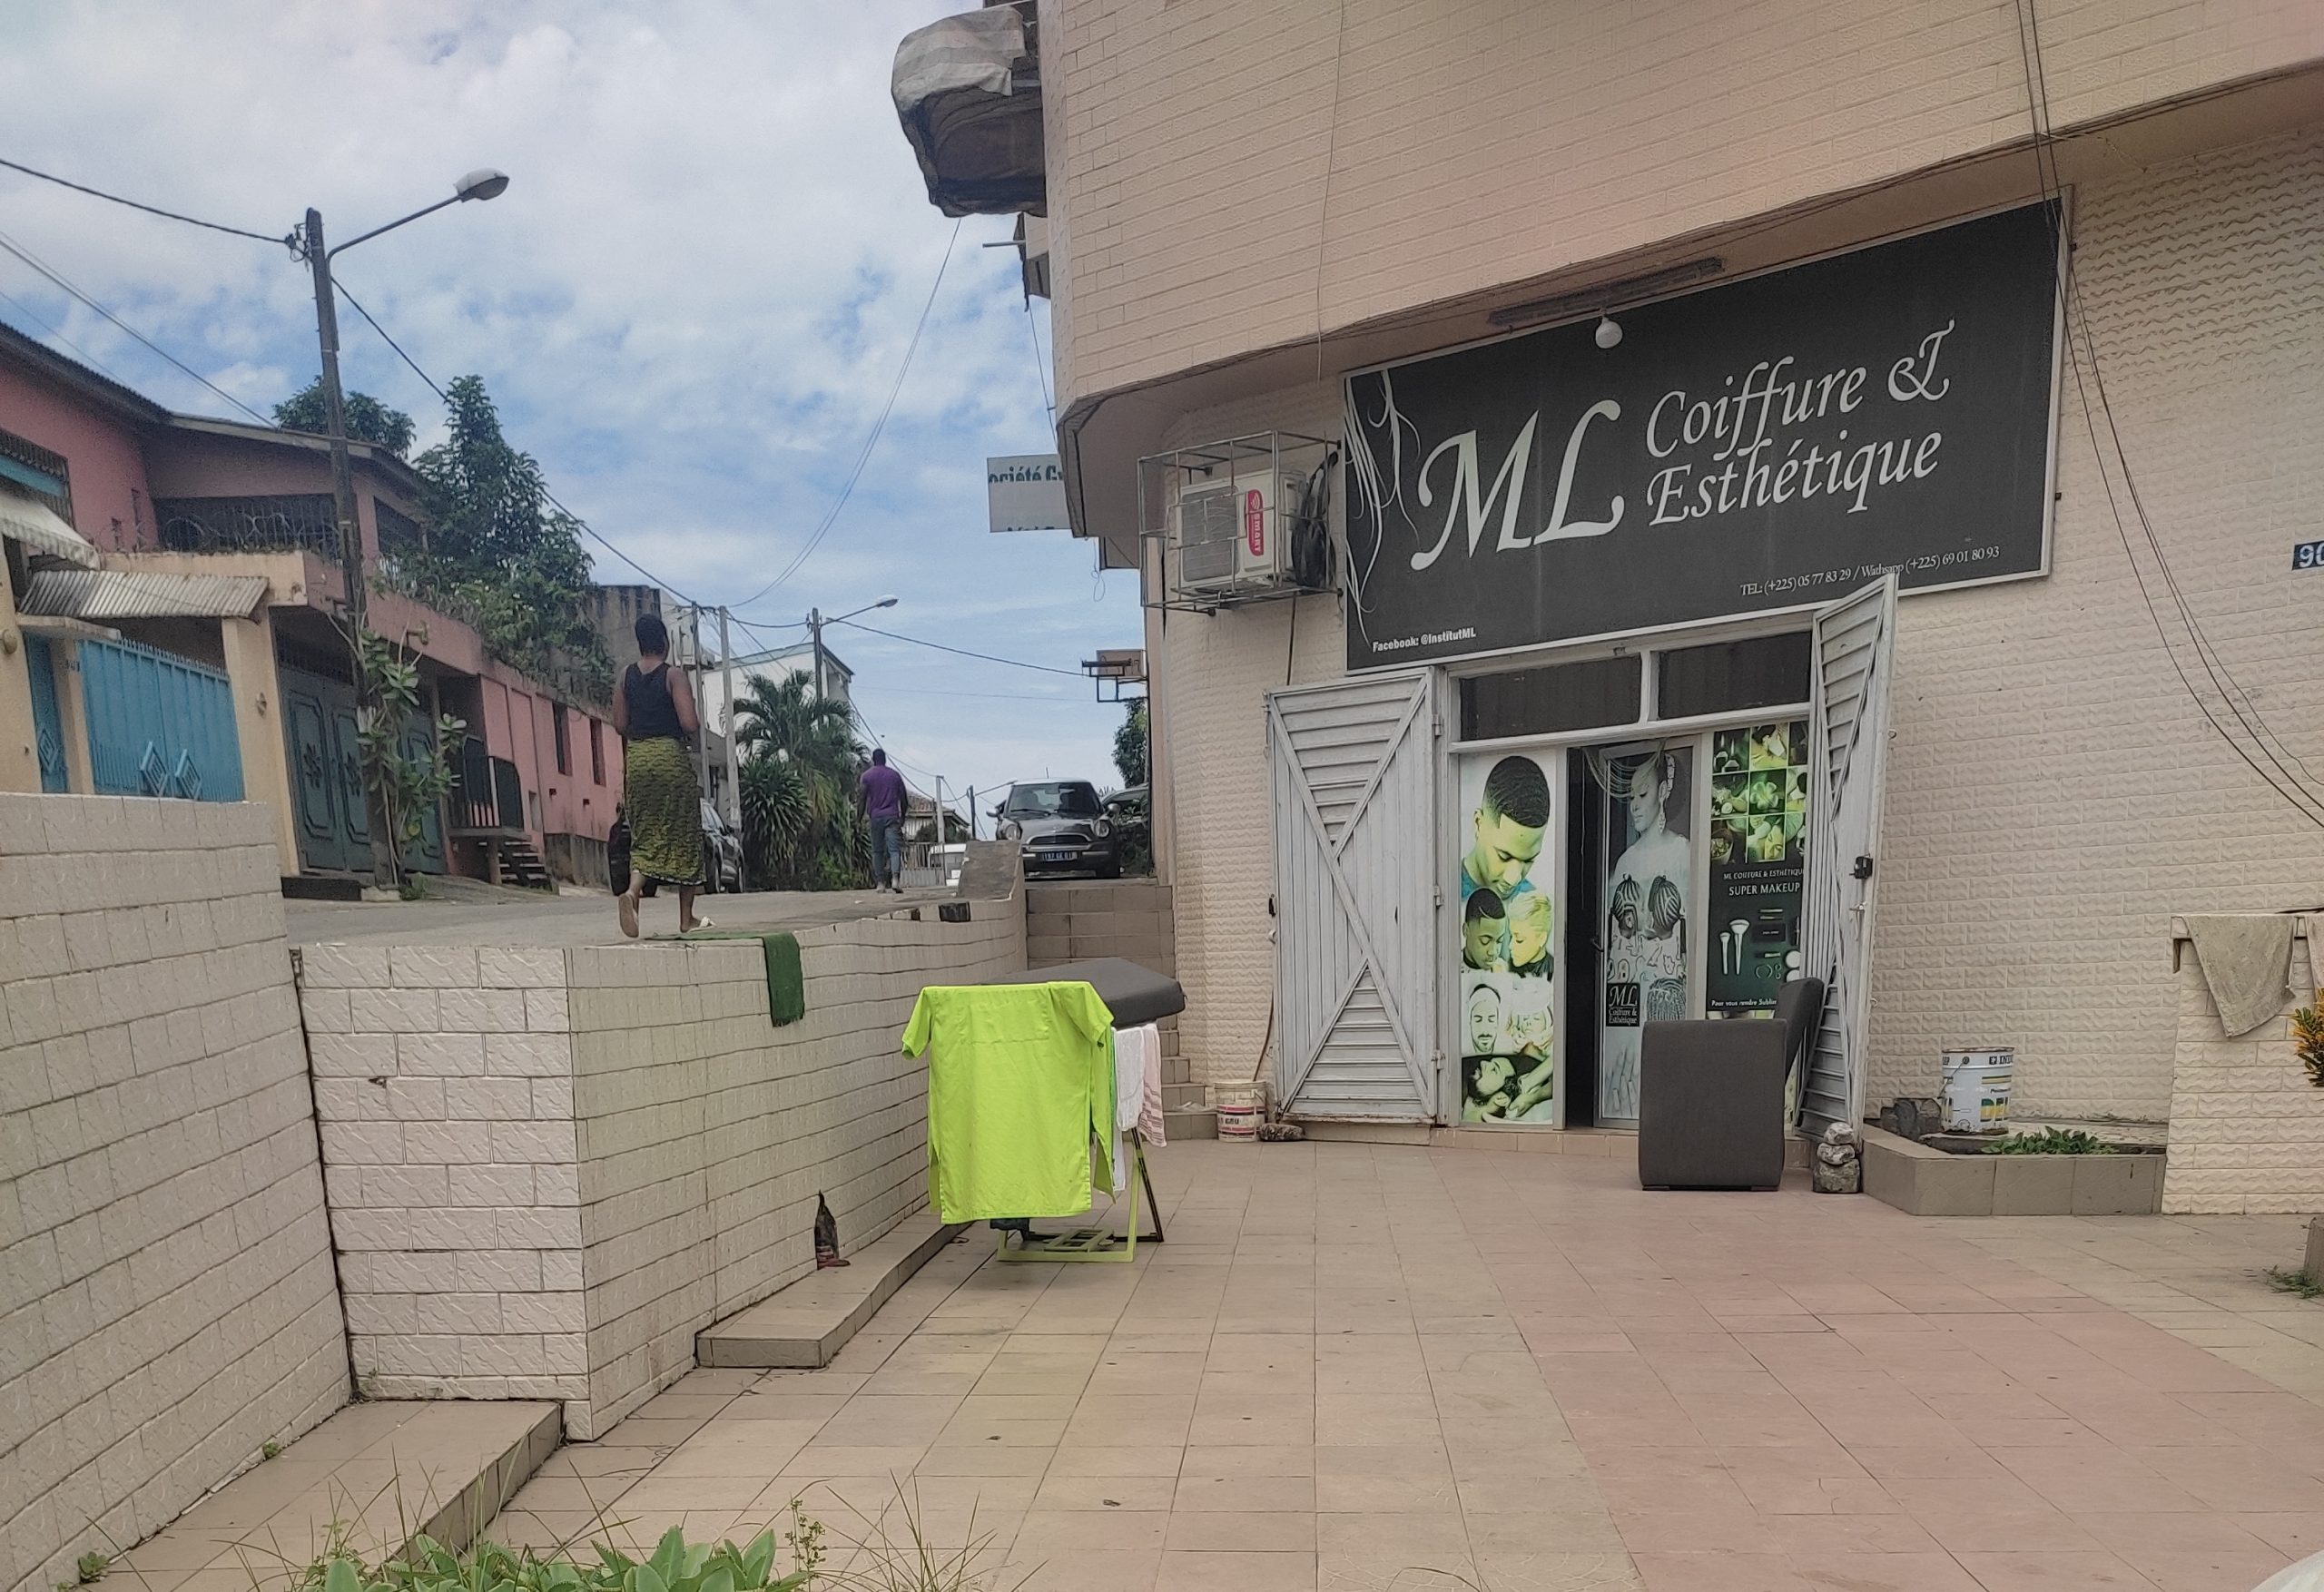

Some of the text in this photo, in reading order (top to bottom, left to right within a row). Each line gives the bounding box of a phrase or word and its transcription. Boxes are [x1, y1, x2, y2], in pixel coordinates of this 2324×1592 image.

[1646, 319, 1955, 461] Coiffure &
[1410, 398, 1625, 571] ML
[1646, 431, 1943, 527] Esthétique
[1740, 583, 1763, 595] TEL:
[1764, 576, 1797, 595] (+225)
[1797, 575, 1810, 587] 05
[1812, 572, 1824, 585] 77
[1826, 570, 1837, 583] 83
[1838, 568, 1851, 581] 29
[1906, 555, 1941, 575] (+225)
[1942, 553, 1955, 565] 69
[1956, 550, 1969, 562] 01
[1972, 548, 1985, 561] 80
[1986, 545, 2000, 558] 93
[1372, 626, 1476, 653] Facebook: @InstitutML
[1728, 881, 1801, 897] SUPER MAKEUP
[1608, 984, 1638, 1007] ML
